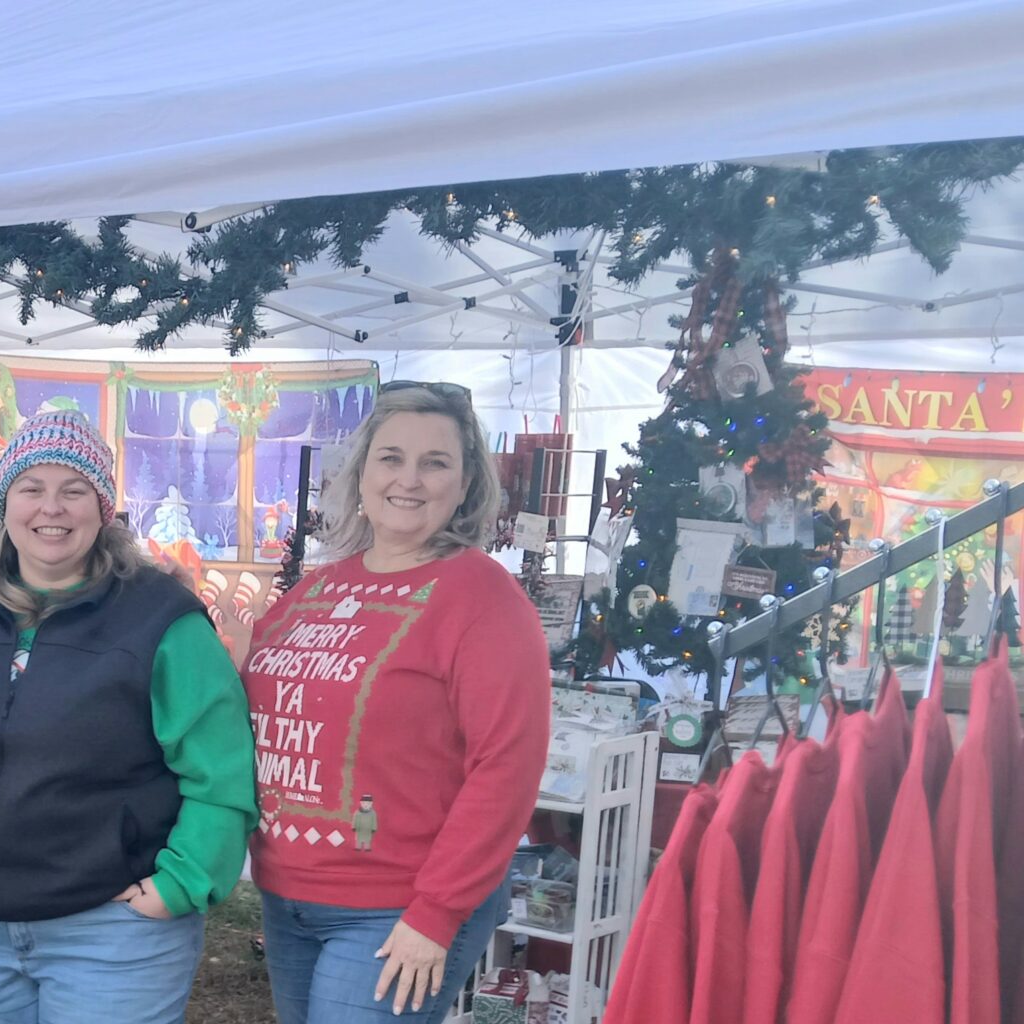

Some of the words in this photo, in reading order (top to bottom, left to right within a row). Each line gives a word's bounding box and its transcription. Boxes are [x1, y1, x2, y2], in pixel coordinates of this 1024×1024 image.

[814, 383, 1024, 432] SANTA'
[283, 620, 366, 649] MERRY
[248, 647, 367, 683] CHRISTMAS
[274, 681, 305, 715] YA
[255, 749, 323, 792] NIMAL
